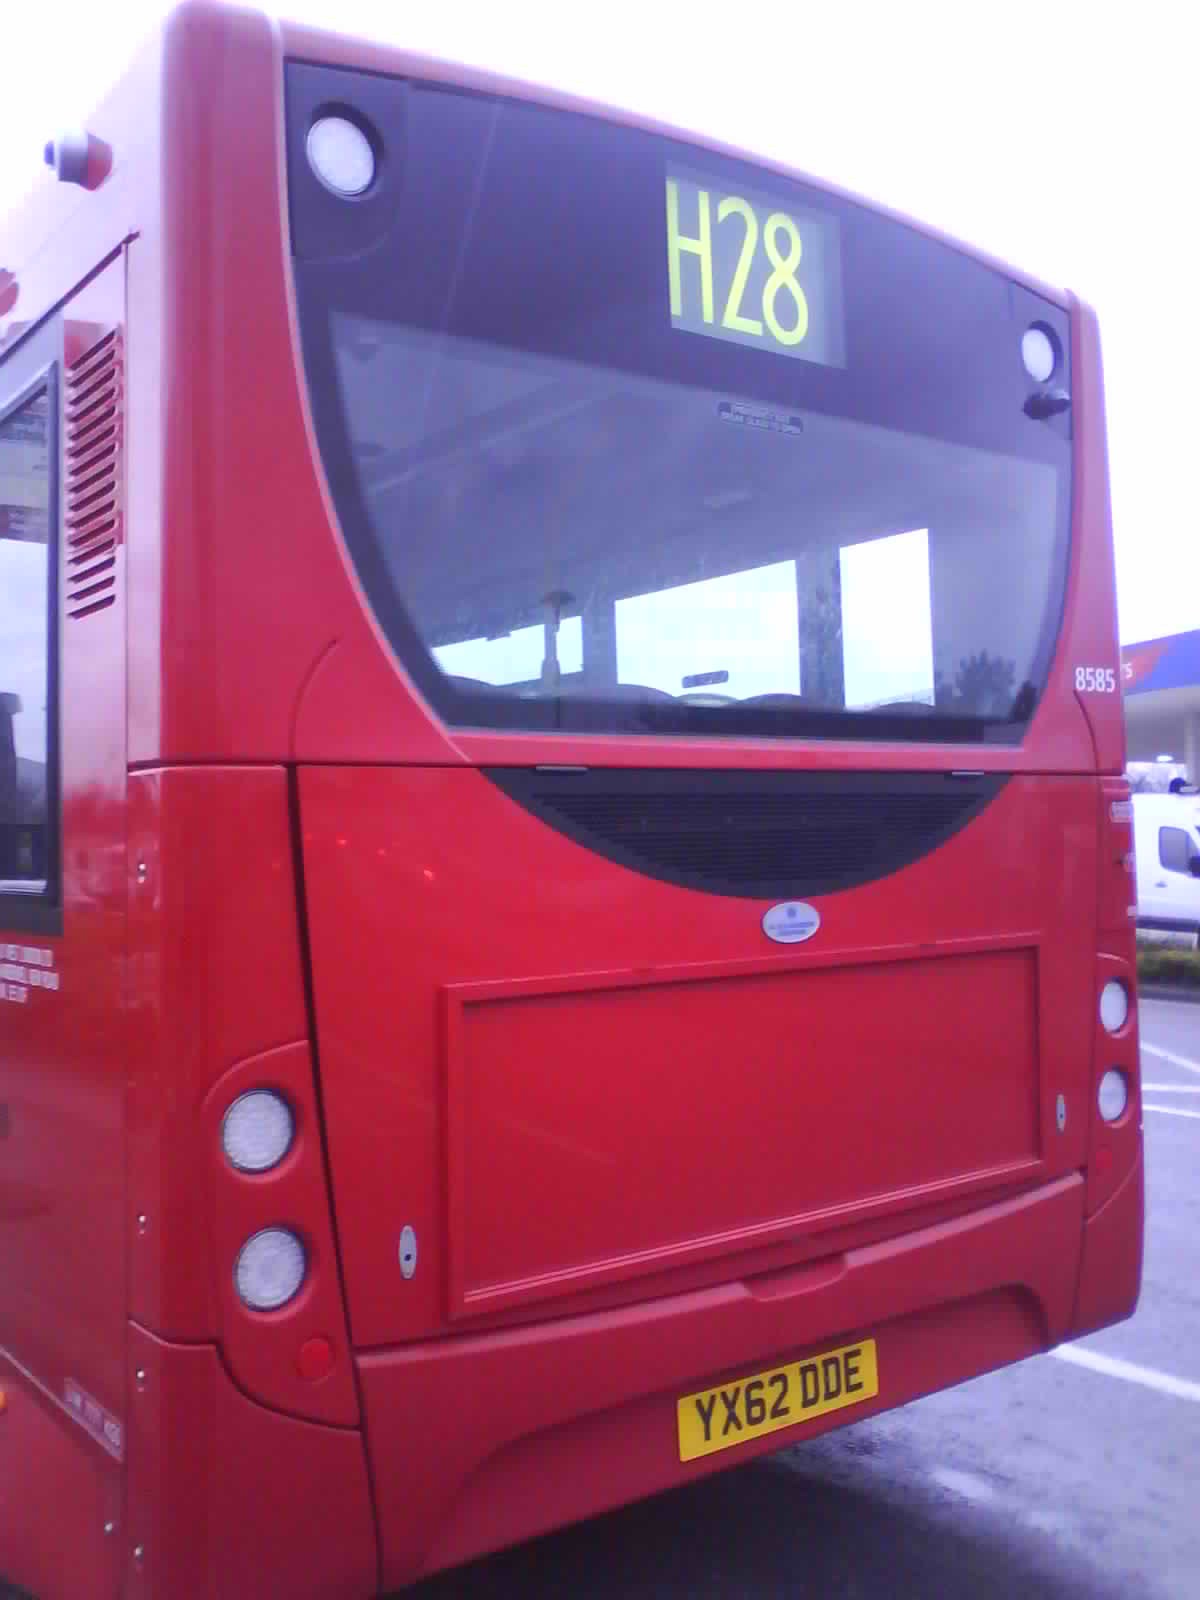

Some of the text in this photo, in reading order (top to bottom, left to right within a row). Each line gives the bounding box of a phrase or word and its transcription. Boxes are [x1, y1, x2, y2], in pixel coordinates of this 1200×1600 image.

[666, 176, 809, 346] H28
[1075, 667, 1115, 693] 8585
[695, 1349, 864, 1441] YX62 DDE
